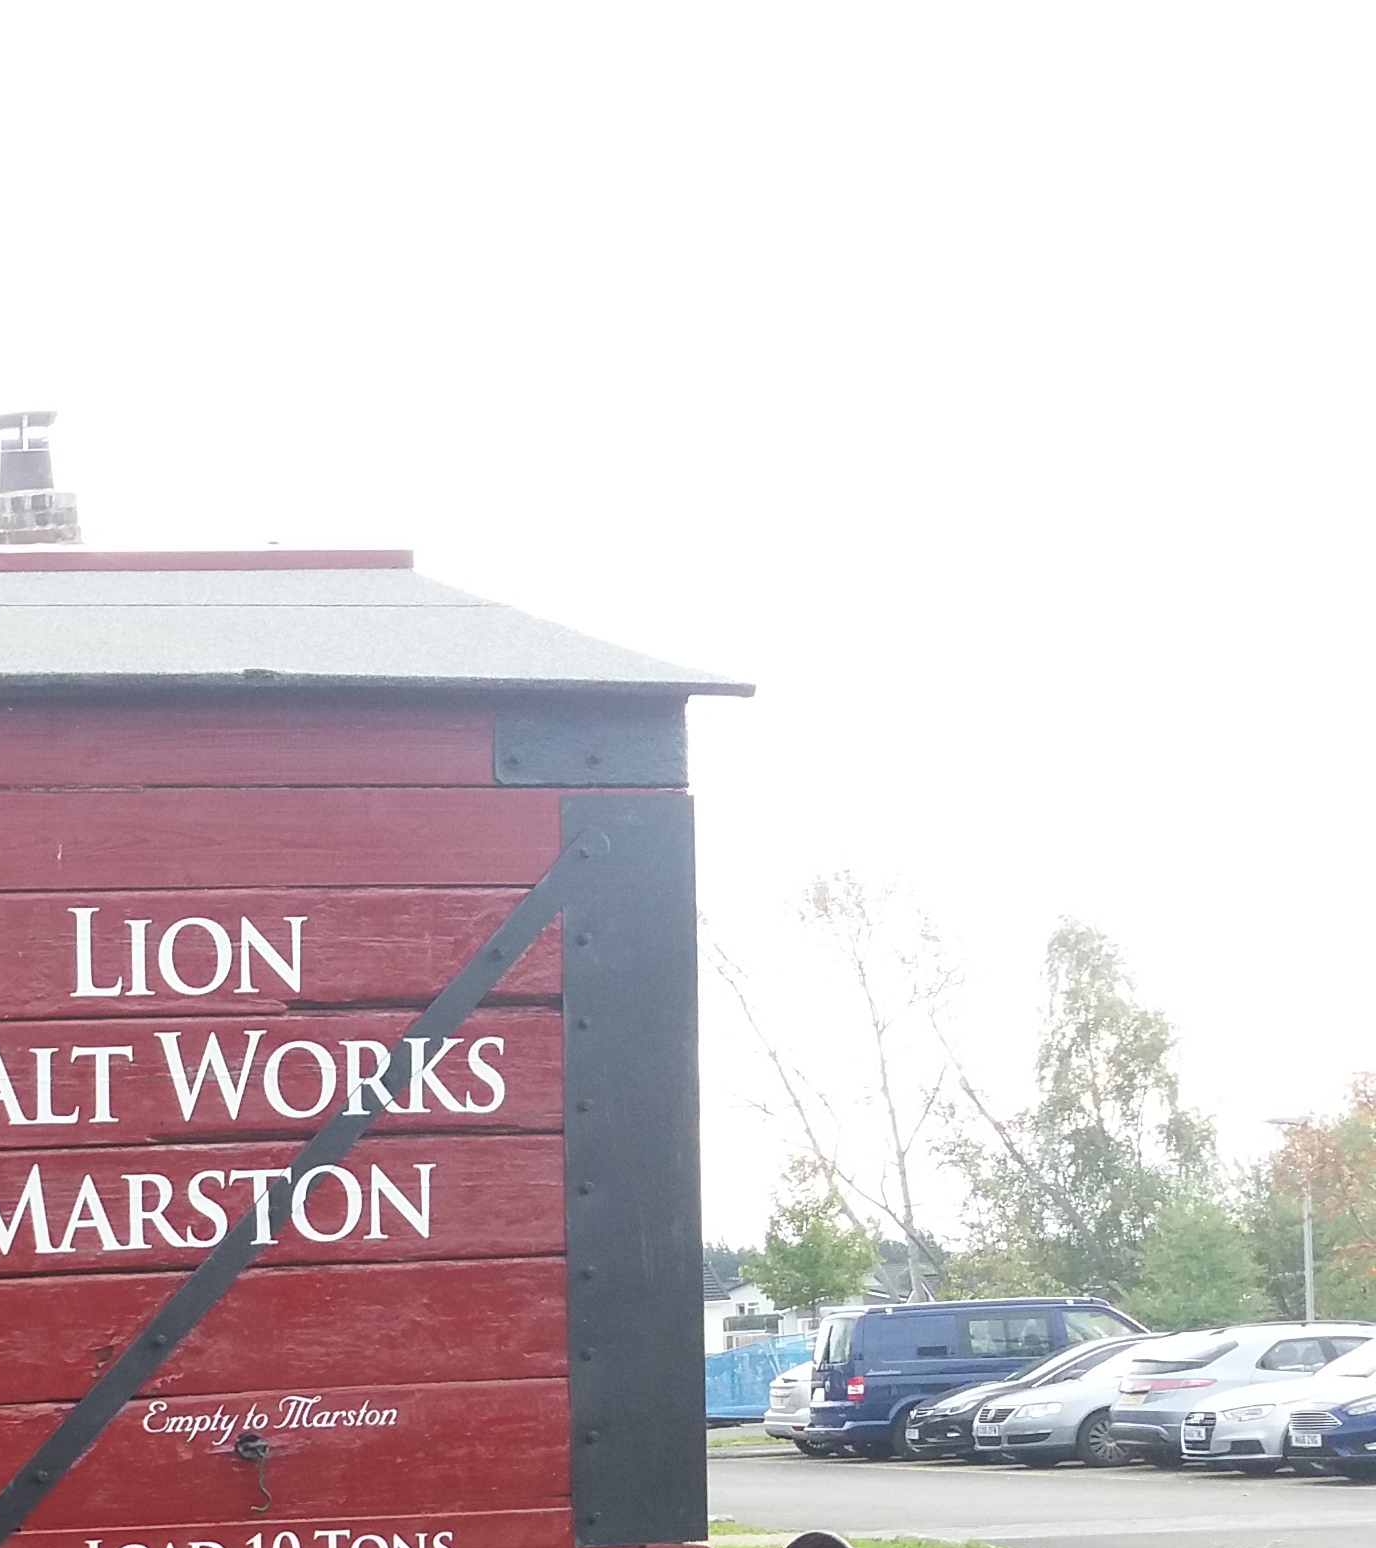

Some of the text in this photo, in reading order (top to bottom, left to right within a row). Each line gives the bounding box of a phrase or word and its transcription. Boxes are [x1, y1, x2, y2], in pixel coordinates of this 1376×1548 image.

[67, 907, 308, 997] LION
[153, 1030, 505, 1121] WORKS
[142, 1395, 397, 1445] Empty to Marston
